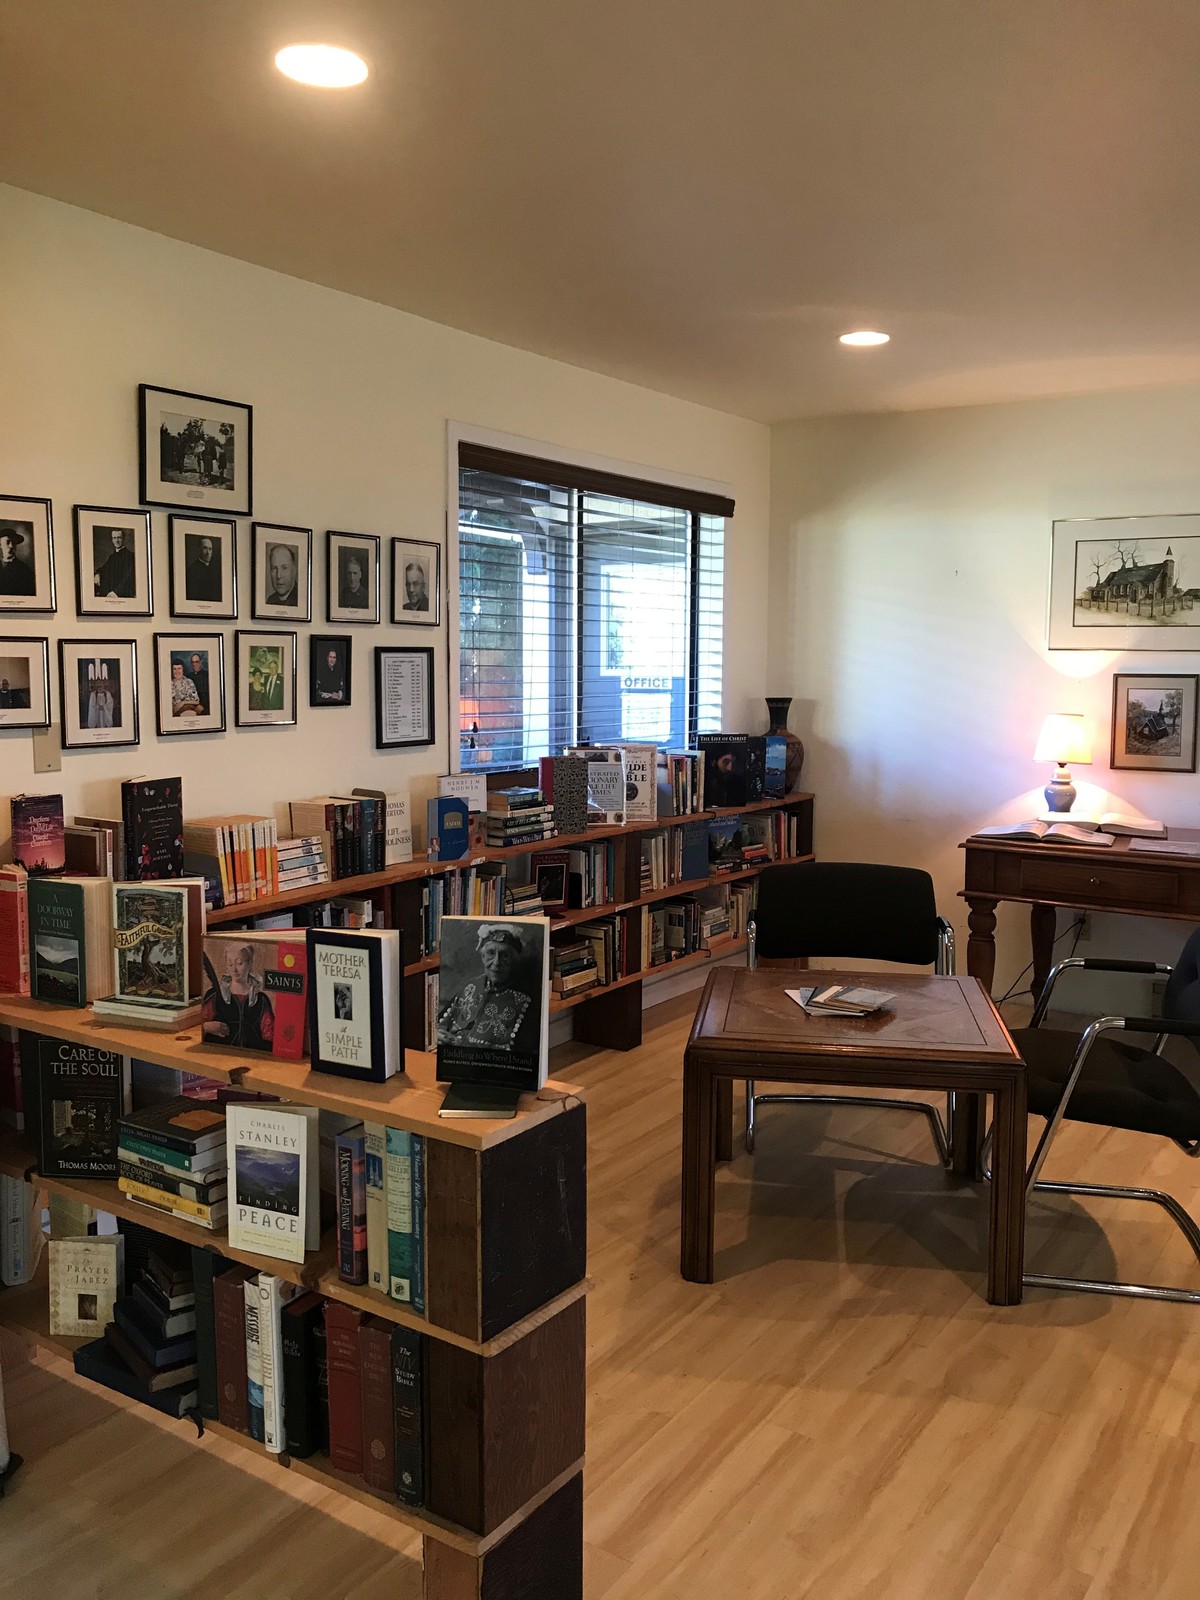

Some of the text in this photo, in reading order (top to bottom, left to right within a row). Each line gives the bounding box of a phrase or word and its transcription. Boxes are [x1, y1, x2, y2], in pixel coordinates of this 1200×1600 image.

[624, 677, 668, 688] OFFICE
[626, 774, 647, 782] BLE
[386, 801, 405, 810] HOMAS
[386, 809, 405, 818] ERTON
[387, 827, 399, 836] LIFE
[52, 893, 59, 904] A
[36, 903, 74, 918] DOORWAY
[40, 915, 72, 930] IN TIME
[117, 923, 151, 946] FAITHFUL
[318, 951, 367, 969] MOTHER
[322, 964, 362, 980] TERESA
[266, 972, 301, 989] SAINTS
[325, 1032, 363, 1049] SIMPLE
[331, 1045, 359, 1060] PATH
[443, 1048, 474, 1061] Paddling
[483, 1051, 508, 1063] Where
[512, 1055, 533, 1066] Stand
[50, 1062, 118, 1077] THE SOUL
[250, 1120, 286, 1131] CHARLES
[239, 1130, 297, 1148] STANLEY
[57, 1160, 88, 1170] THOMAS
[339, 1150, 351, 1187] MORNING
[239, 1208, 298, 1234] PEACE
[340, 1197, 352, 1231] EVENING
[66, 1264, 109, 1275] PRAYER
[75, 1274, 109, 1285] JABEZ
[245, 1303, 260, 1345] MESSAGE
[399, 1346, 412, 1357] The
[395, 1352, 417, 1371] NIV
[262, 1351, 273, 1394] BIBLE
[394, 1366, 416, 1380] STUDY
[395, 1375, 415, 1387] BIBLE
